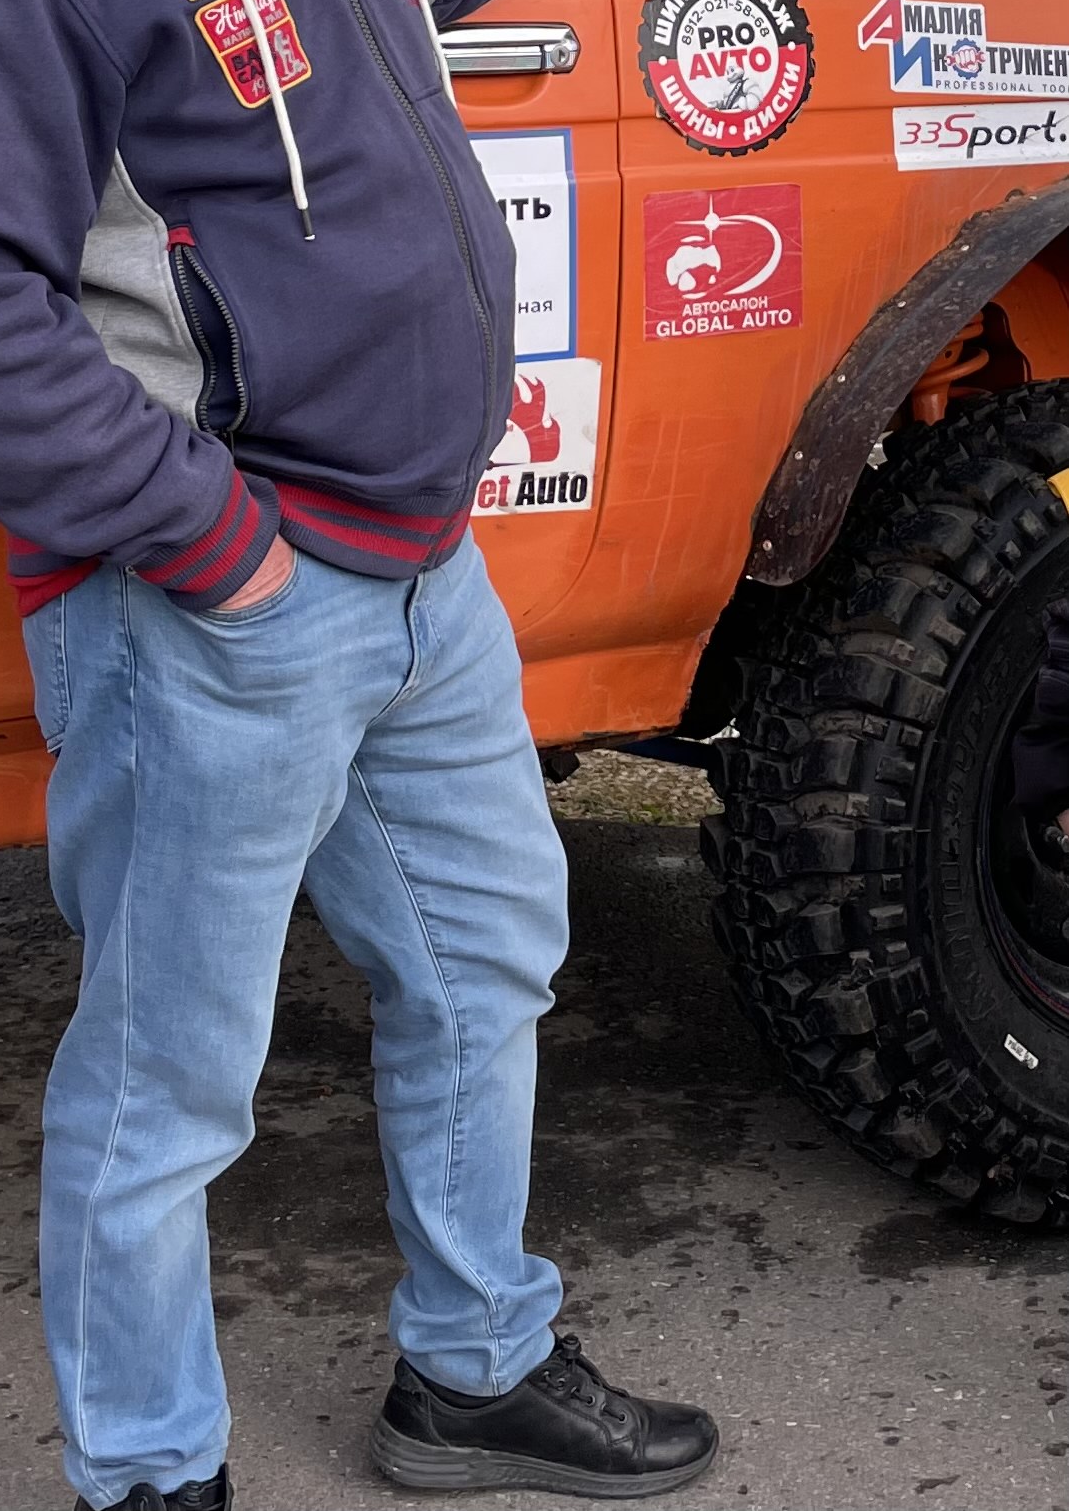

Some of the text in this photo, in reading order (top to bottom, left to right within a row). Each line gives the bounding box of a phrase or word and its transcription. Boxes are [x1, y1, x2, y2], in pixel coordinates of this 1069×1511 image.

[697, 22, 756, 50] PRO
[689, 46, 772, 81] AVTO
[659, 61, 801, 141] ШИНЫ ДИСКИ
[935, 79, 1069, 94] PROFESSIONAL TOO
[682, 295, 769, 317] АВТОСАЛОН
[656, 308, 793, 337] GLOBAL AUTO
[515, 471, 588, 506] Auto
